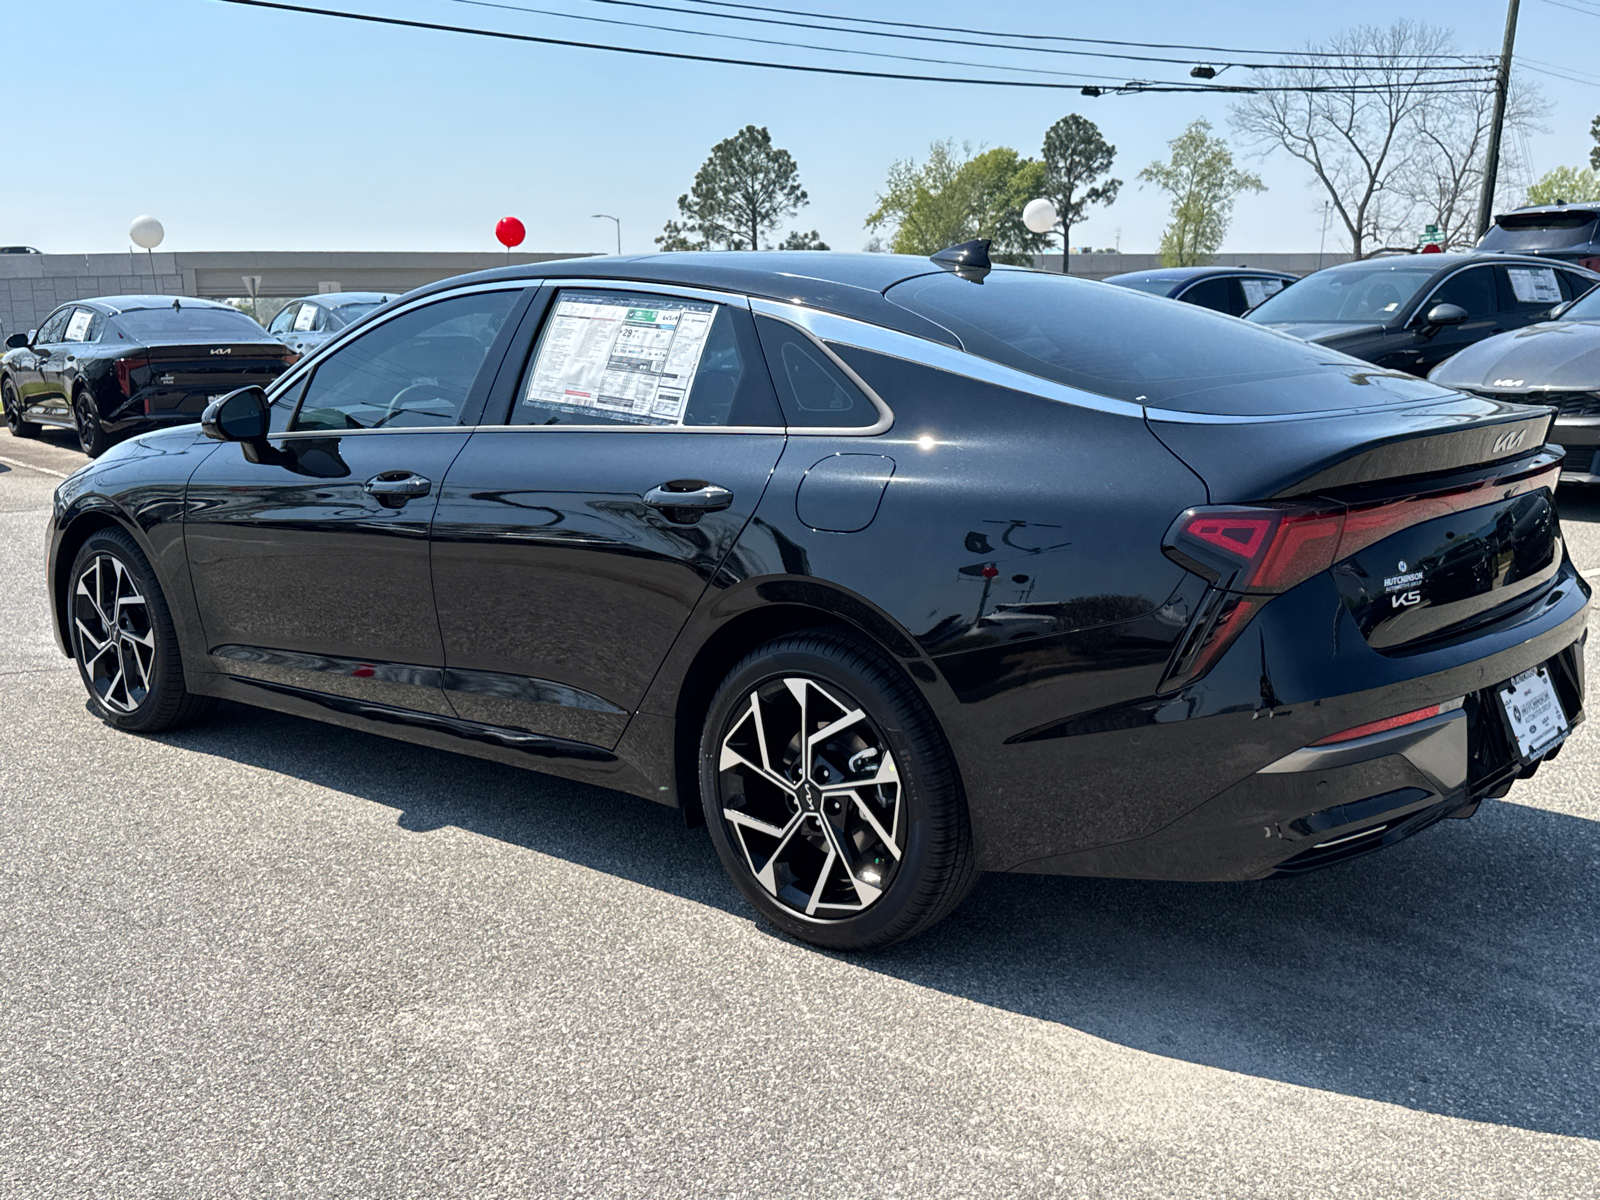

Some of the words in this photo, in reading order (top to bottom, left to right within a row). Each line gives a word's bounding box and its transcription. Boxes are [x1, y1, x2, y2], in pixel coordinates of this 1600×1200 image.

[622, 329, 632, 338] 29
[1492, 428, 1526, 453] KIA
[1384, 572, 1423, 587] HUTCHINSON
[1392, 590, 1421, 608] K5
